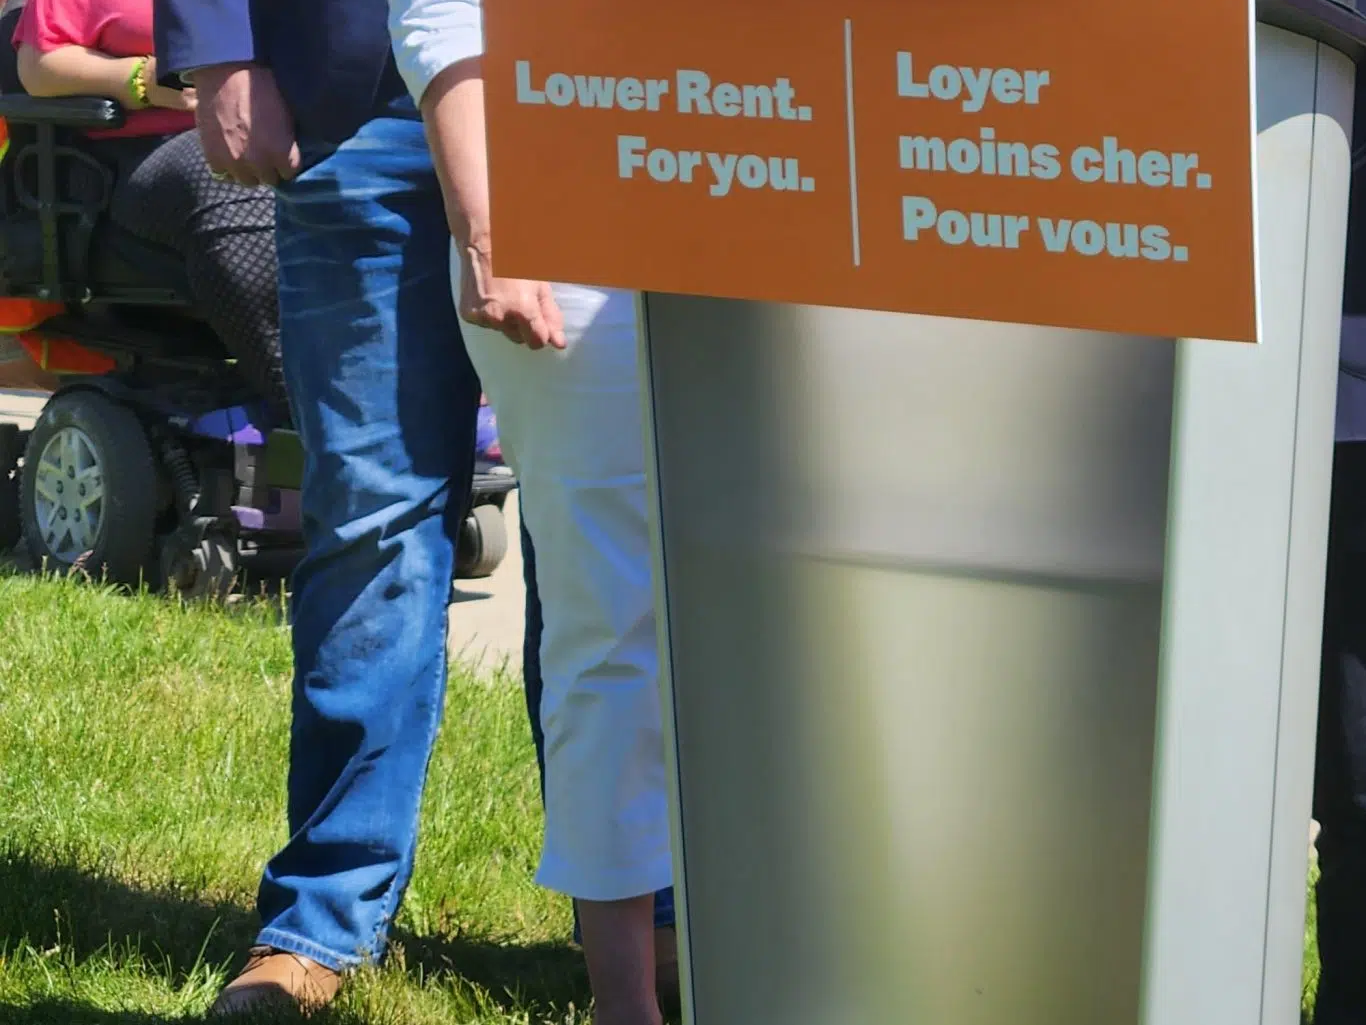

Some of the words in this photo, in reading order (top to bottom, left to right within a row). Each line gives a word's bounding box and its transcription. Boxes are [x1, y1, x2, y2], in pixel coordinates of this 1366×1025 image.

[516, 61, 669, 111] Lower
[676, 70, 812, 121] Rent.
[896, 51, 1049, 113] Loyer
[617, 135, 702, 182] For
[707, 153, 815, 196] you.
[899, 127, 1061, 180] moins
[1071, 136, 1212, 189] cher.
[902, 196, 1029, 249] Pour
[1039, 219, 1188, 261] vous.
